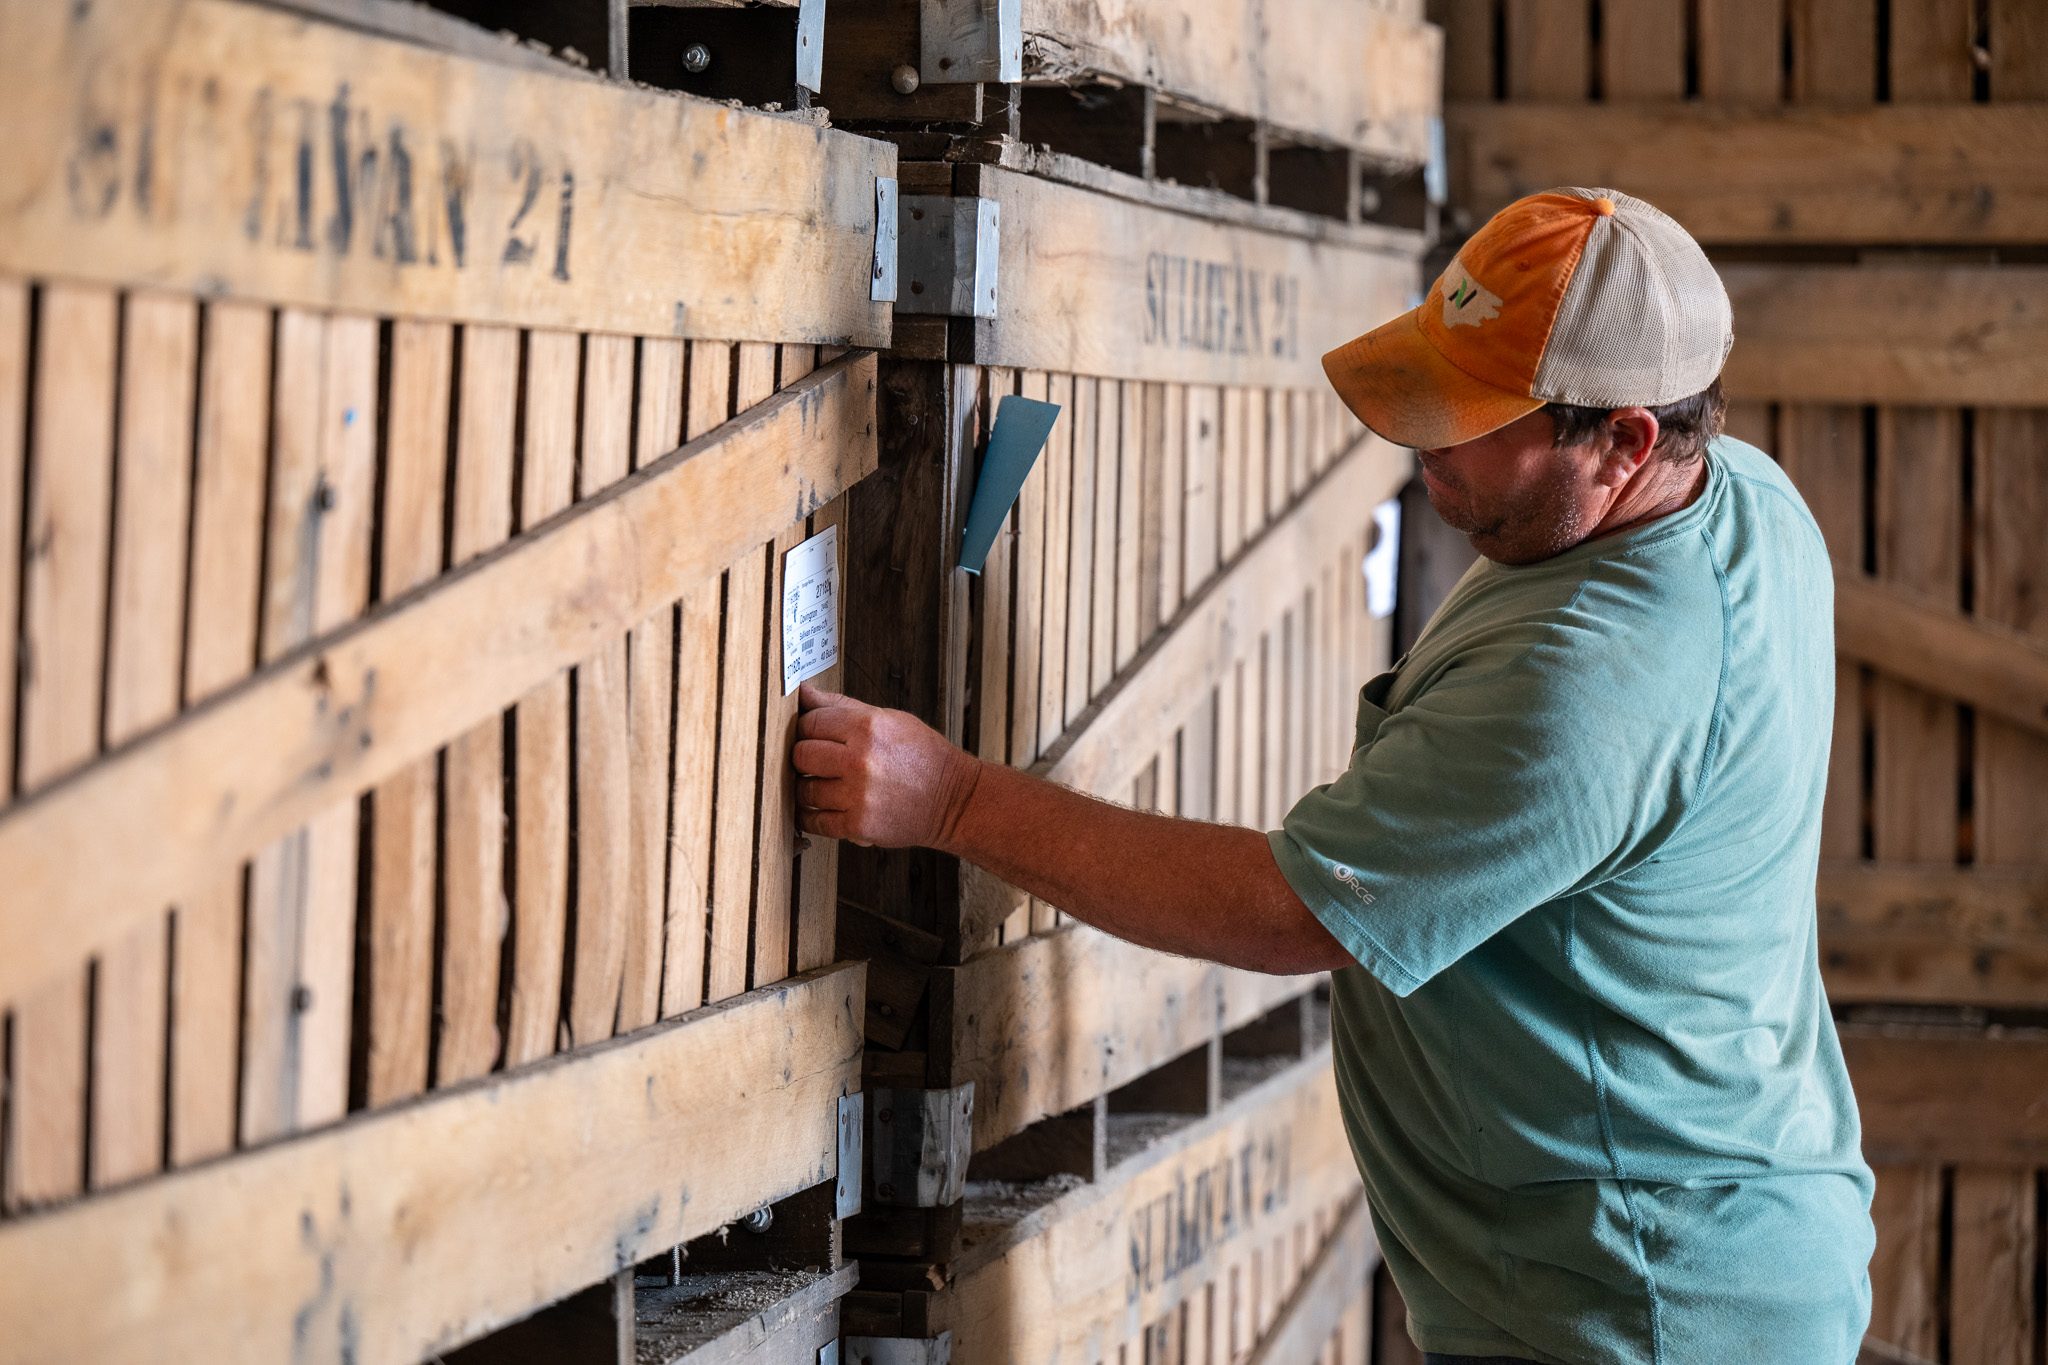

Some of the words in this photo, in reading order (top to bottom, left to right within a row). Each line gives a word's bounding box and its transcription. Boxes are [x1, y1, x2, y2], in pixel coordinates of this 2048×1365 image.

[64, 58, 474, 269] SULIVAN
[502, 137, 575, 283] 21
[1326, 858, 1377, 905] ORCE
